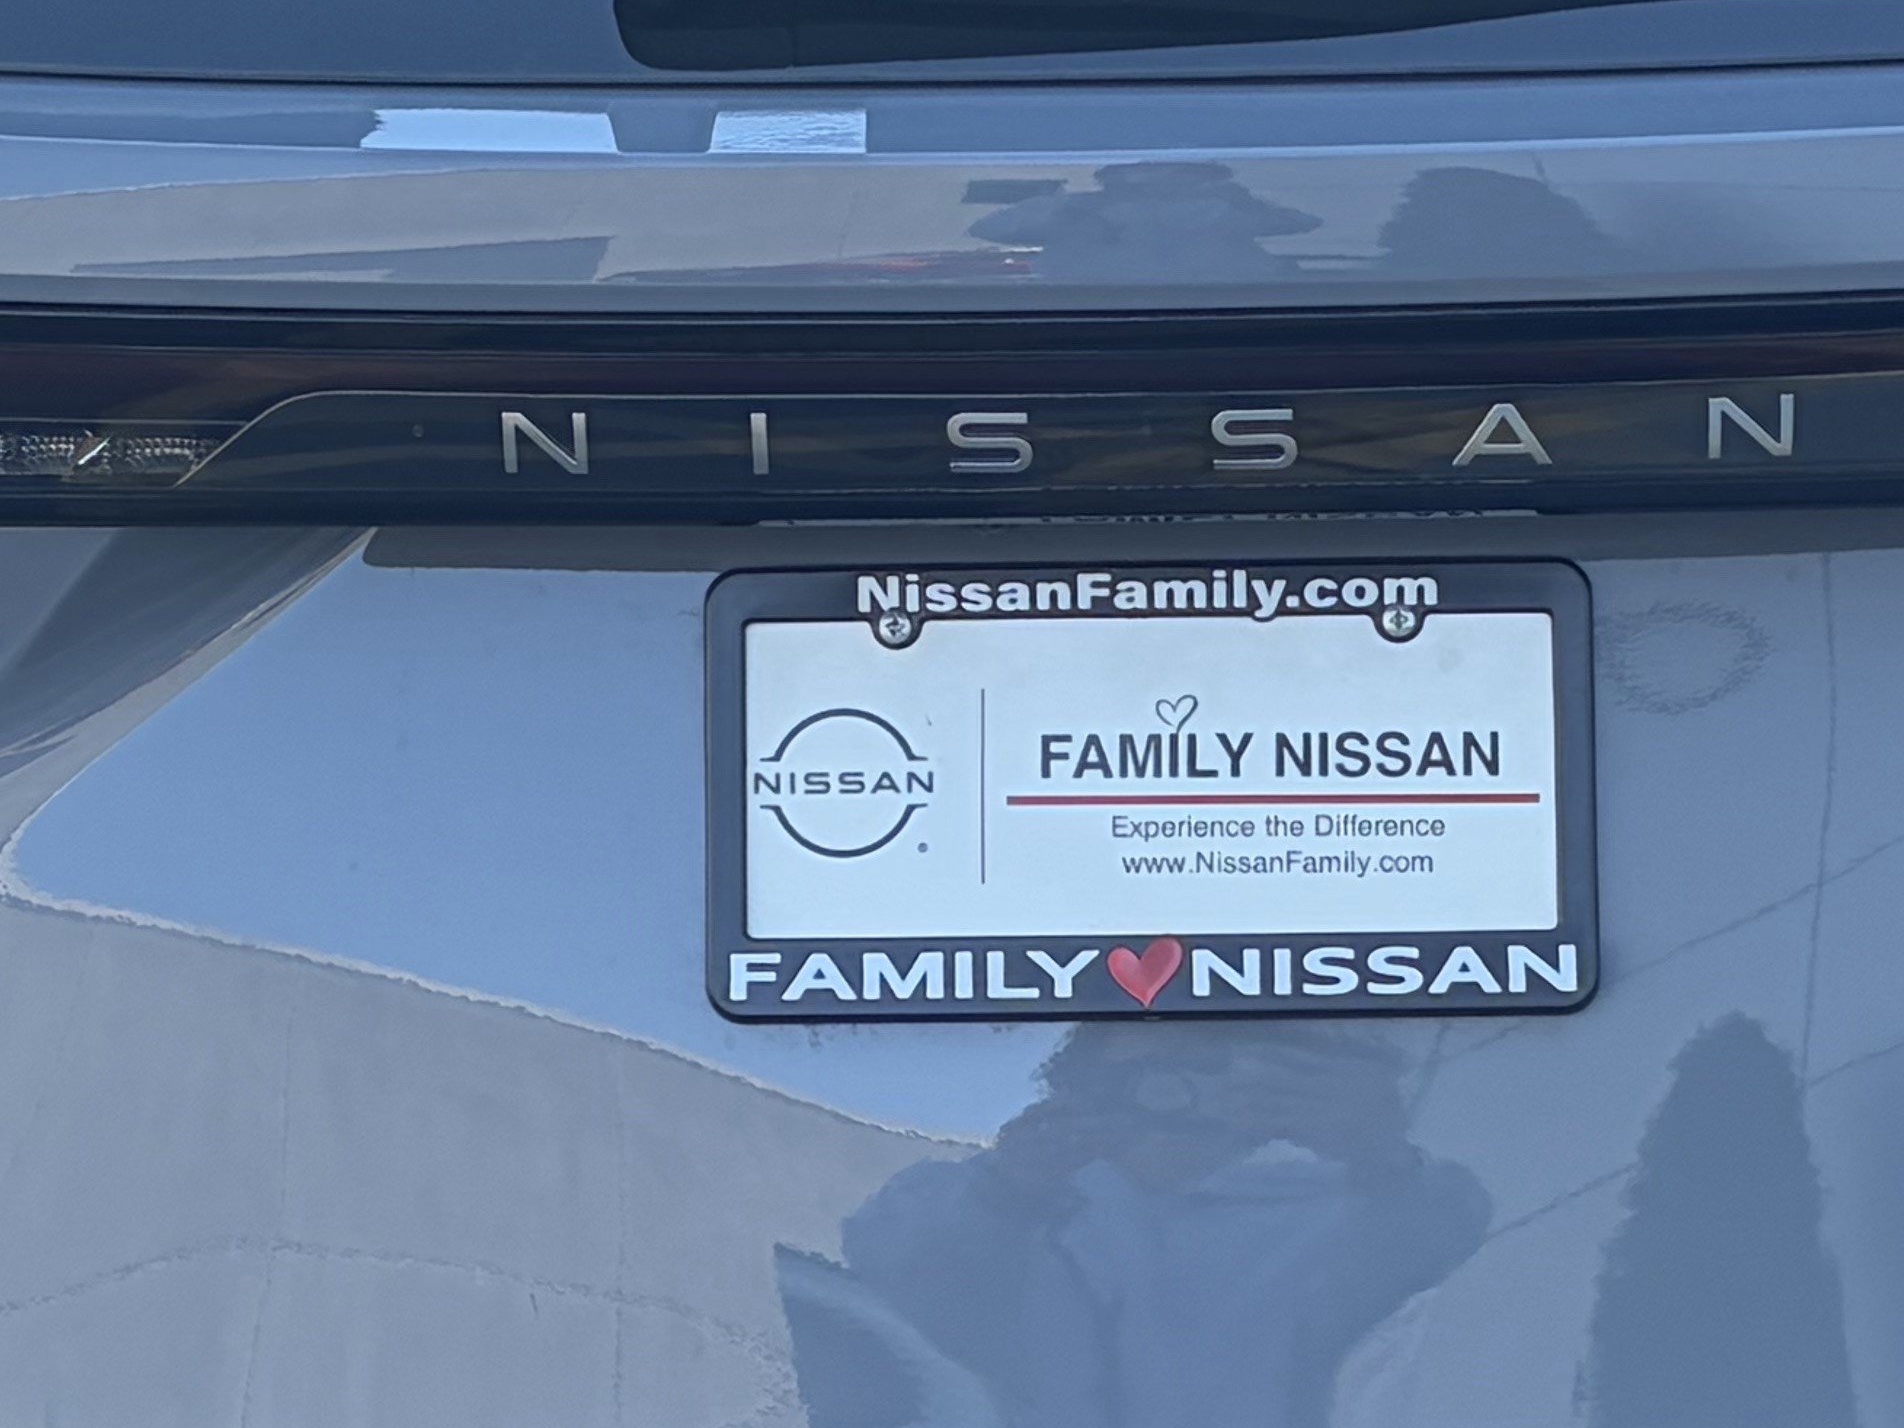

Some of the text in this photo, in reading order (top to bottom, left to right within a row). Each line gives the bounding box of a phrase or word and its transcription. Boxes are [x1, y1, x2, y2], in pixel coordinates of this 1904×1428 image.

[501, 393, 1796, 475] NISSAN
[857, 570, 1438, 619] NissanFamily.com
[1040, 731, 1500, 778] FAMILY NISSAN
[753, 771, 934, 795] NISSAN
[1111, 814, 1446, 842] Experience the Difference
[1122, 849, 1435, 878] www.NissanFamily.com
[728, 944, 1579, 1001] FAMILY NISSAN
